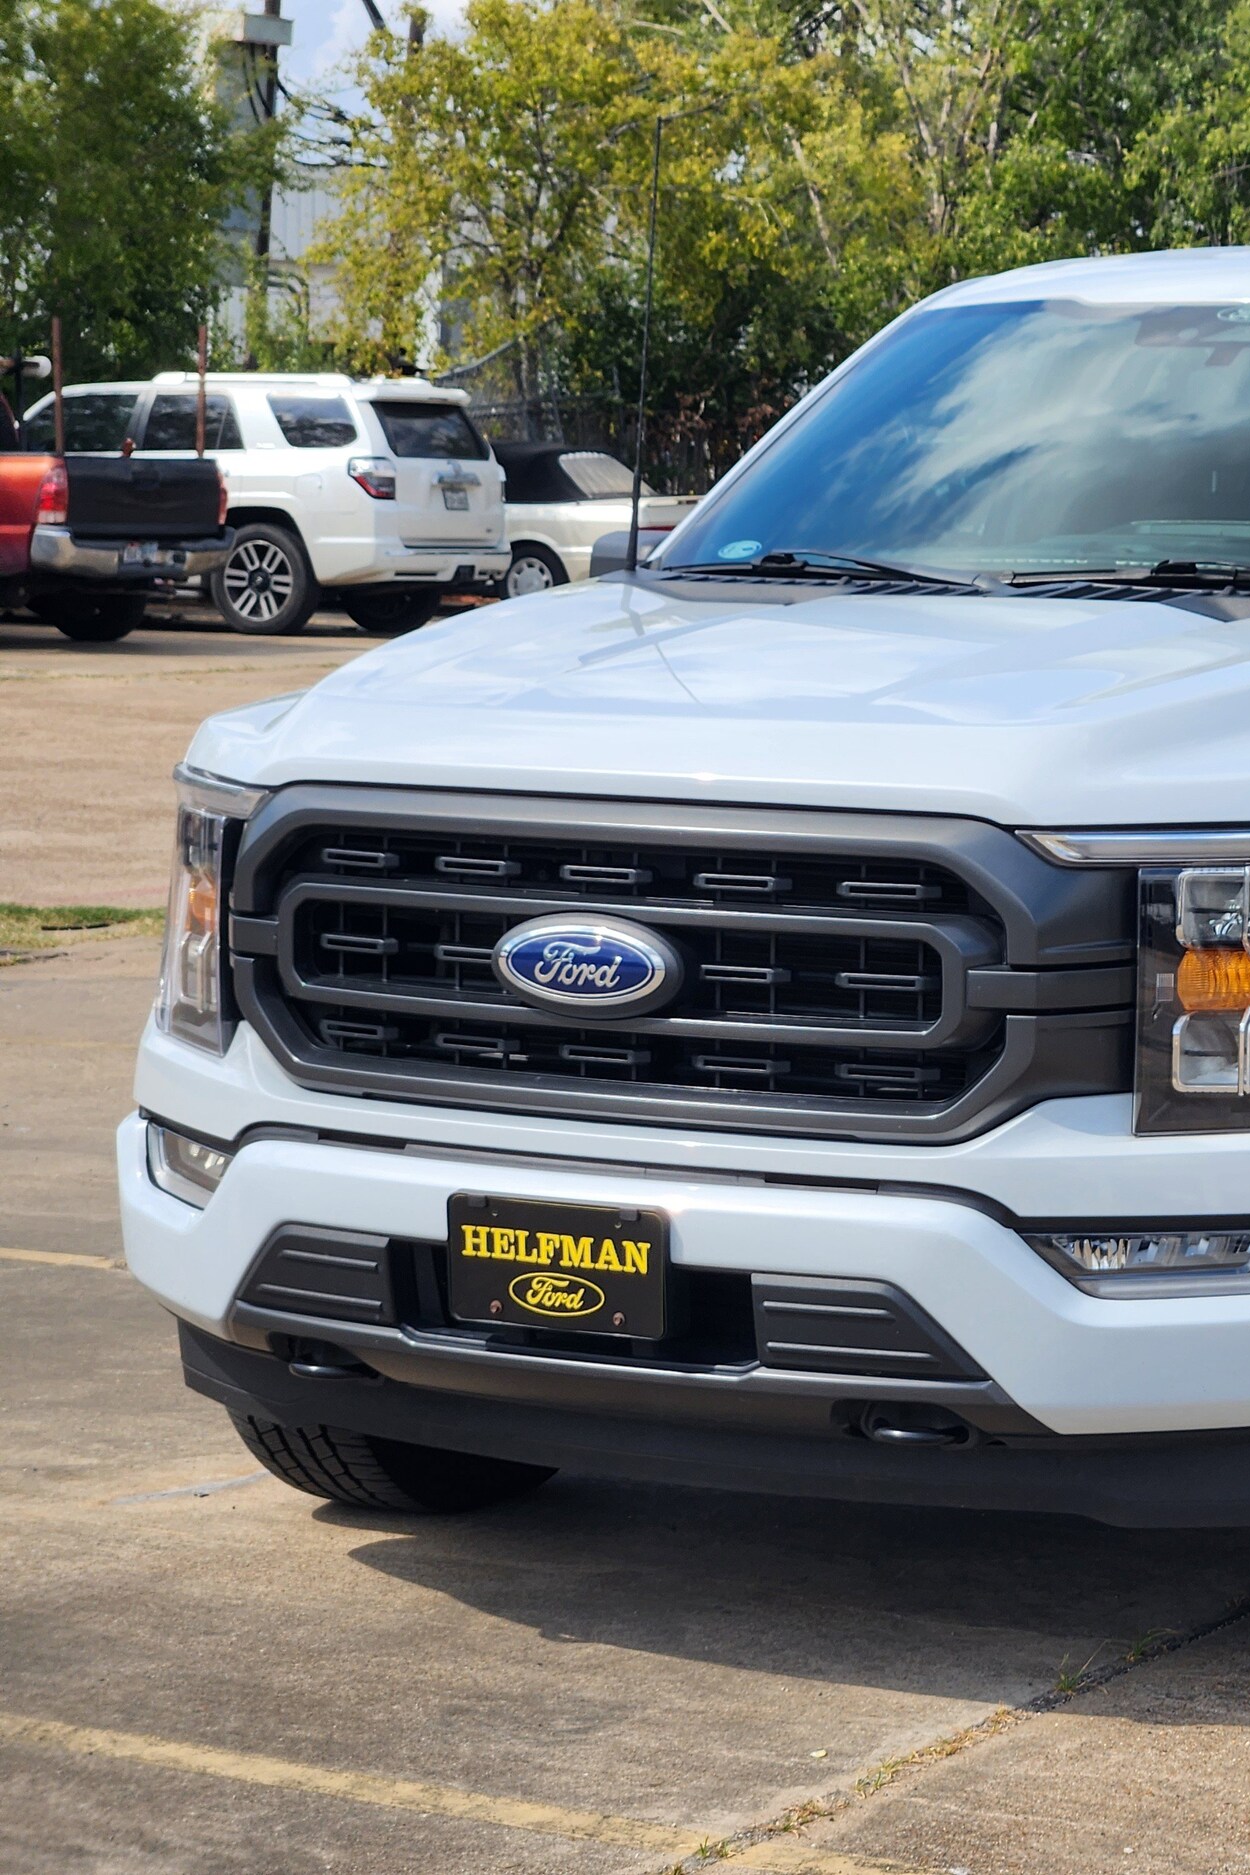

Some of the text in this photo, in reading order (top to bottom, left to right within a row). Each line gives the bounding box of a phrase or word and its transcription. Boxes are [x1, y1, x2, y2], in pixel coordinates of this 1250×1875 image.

[534, 940, 621, 989] Ford
[461, 1224, 651, 1275] HELFMAN
[525, 1275, 586, 1311] Ford
